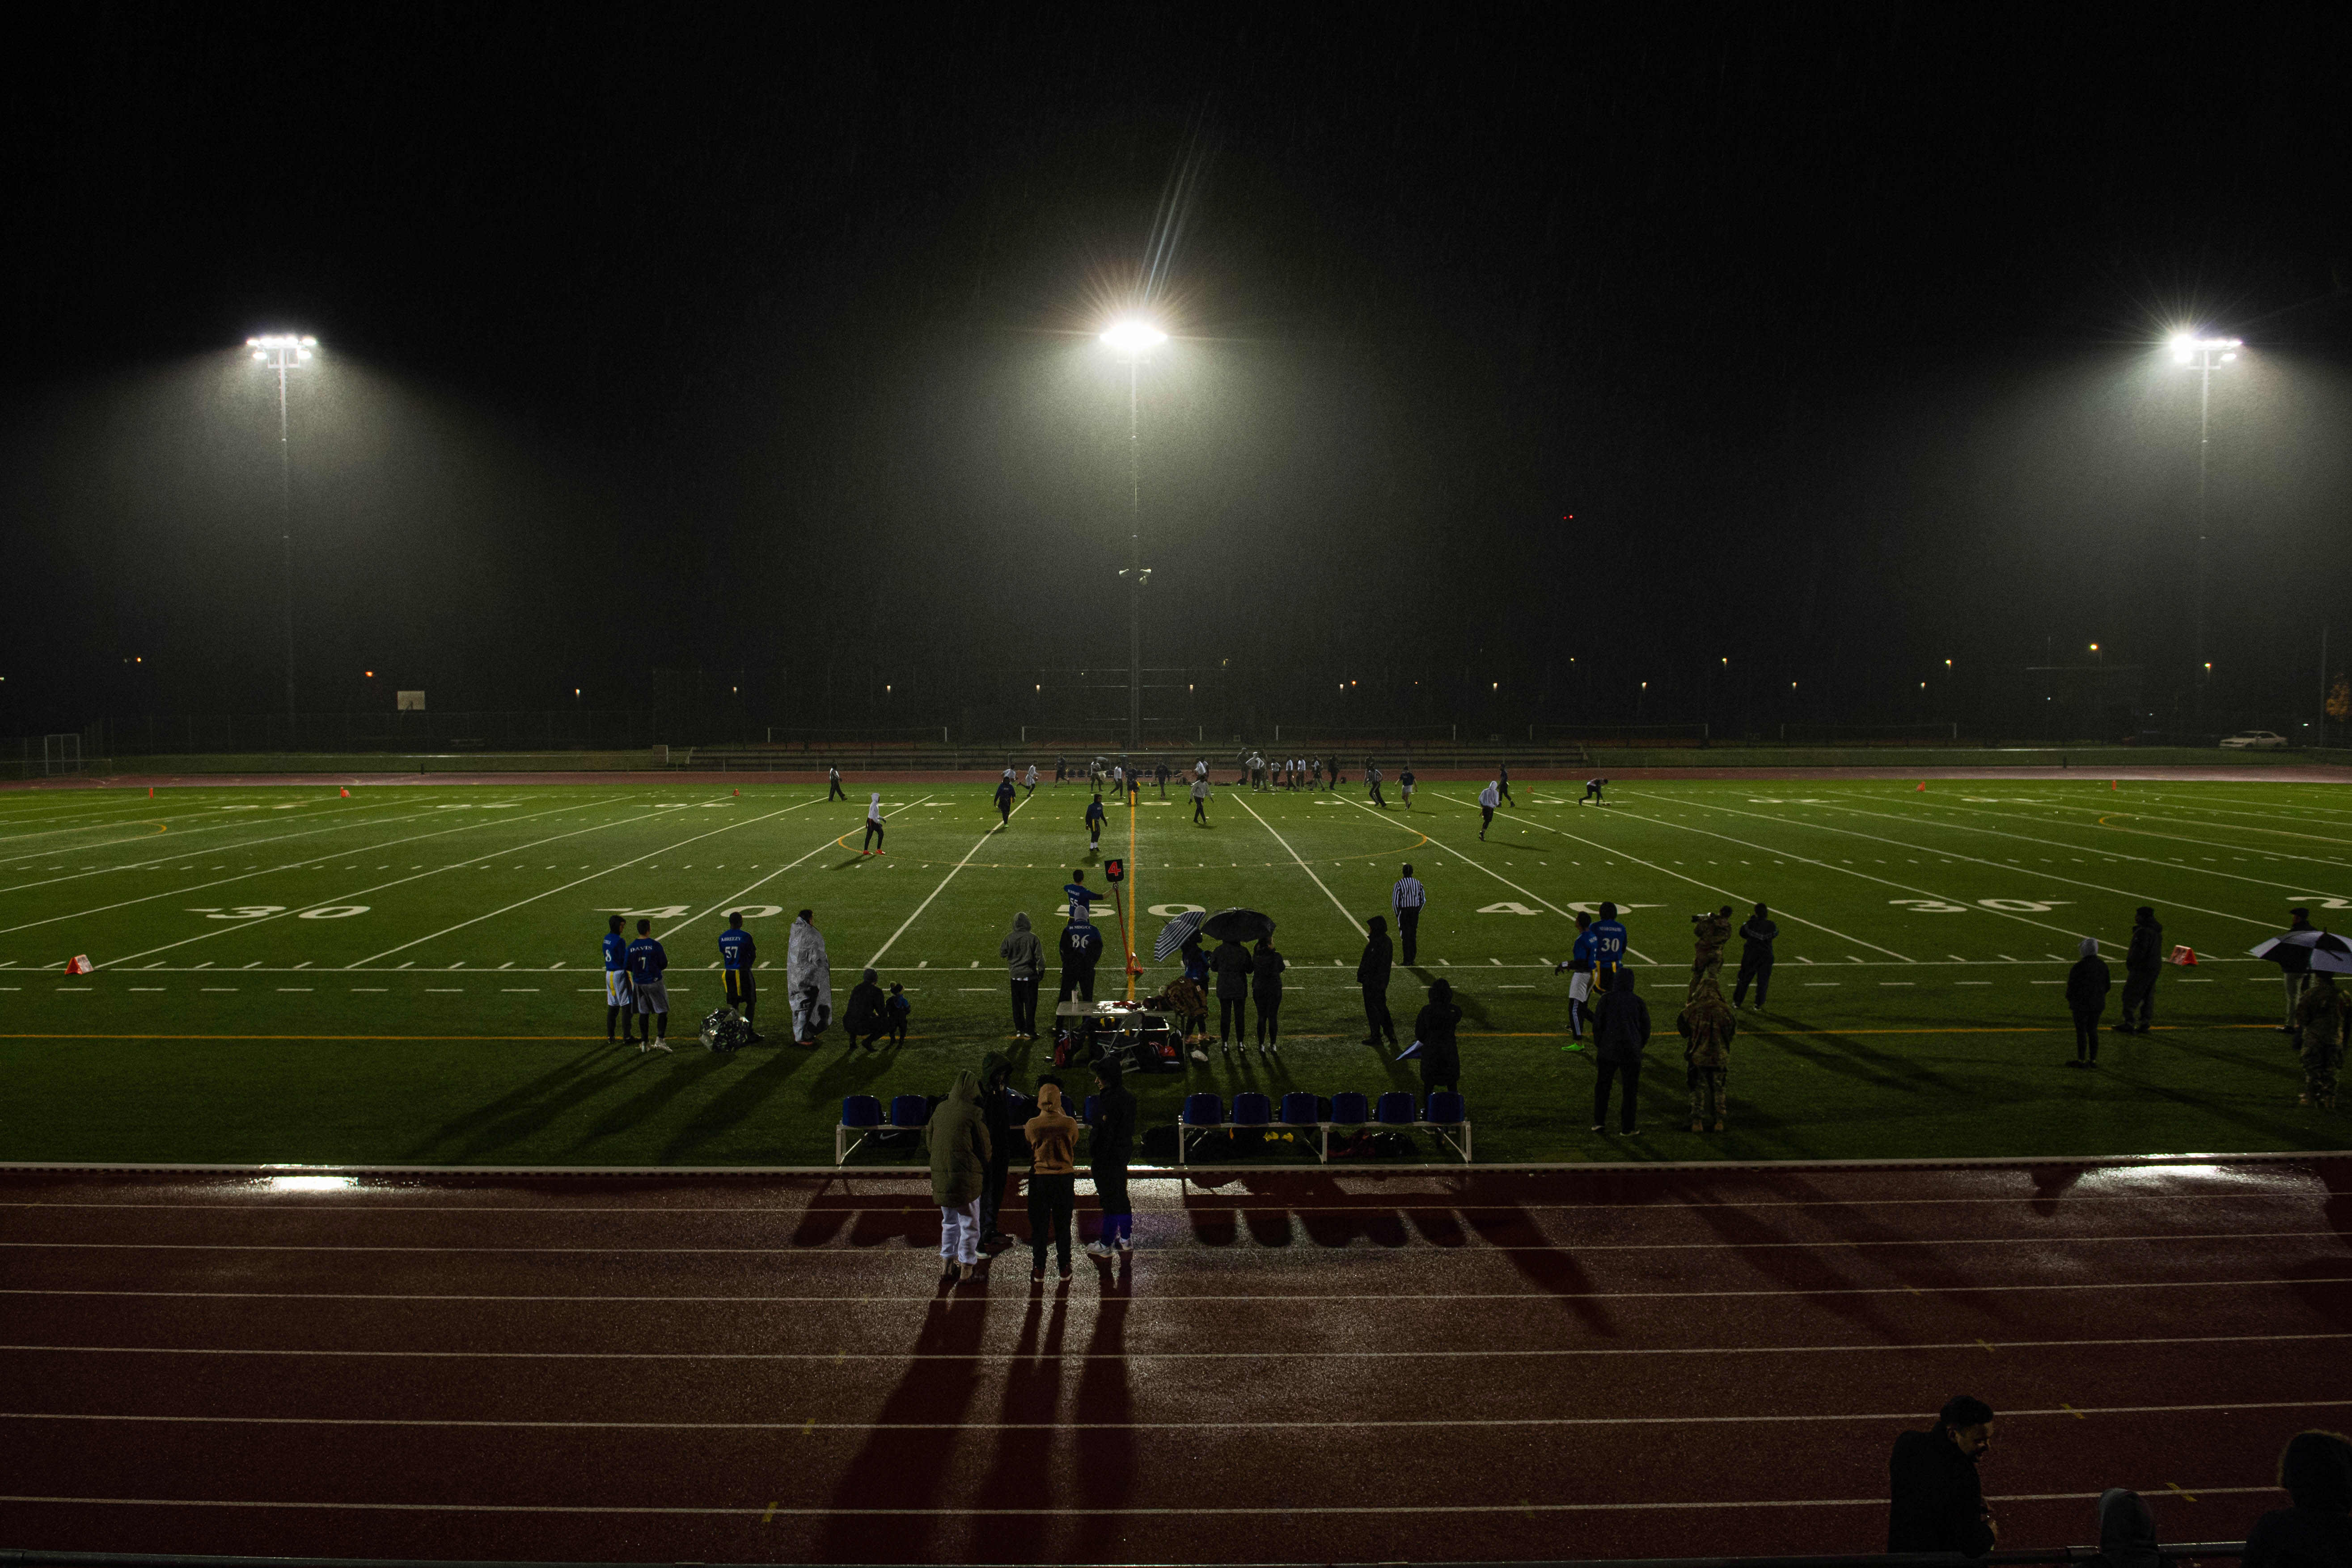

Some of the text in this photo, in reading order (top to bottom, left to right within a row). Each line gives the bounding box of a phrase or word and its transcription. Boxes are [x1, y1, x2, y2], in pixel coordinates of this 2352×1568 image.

[1108, 861, 1121, 876] 4
[1070, 898, 1079, 908] 55
[1071, 934, 1090, 948] 86
[1601, 938, 1620, 952] 30
[605, 949, 612, 962] 8
[725, 946, 739, 959] 57
[638, 956, 646, 970] 7
